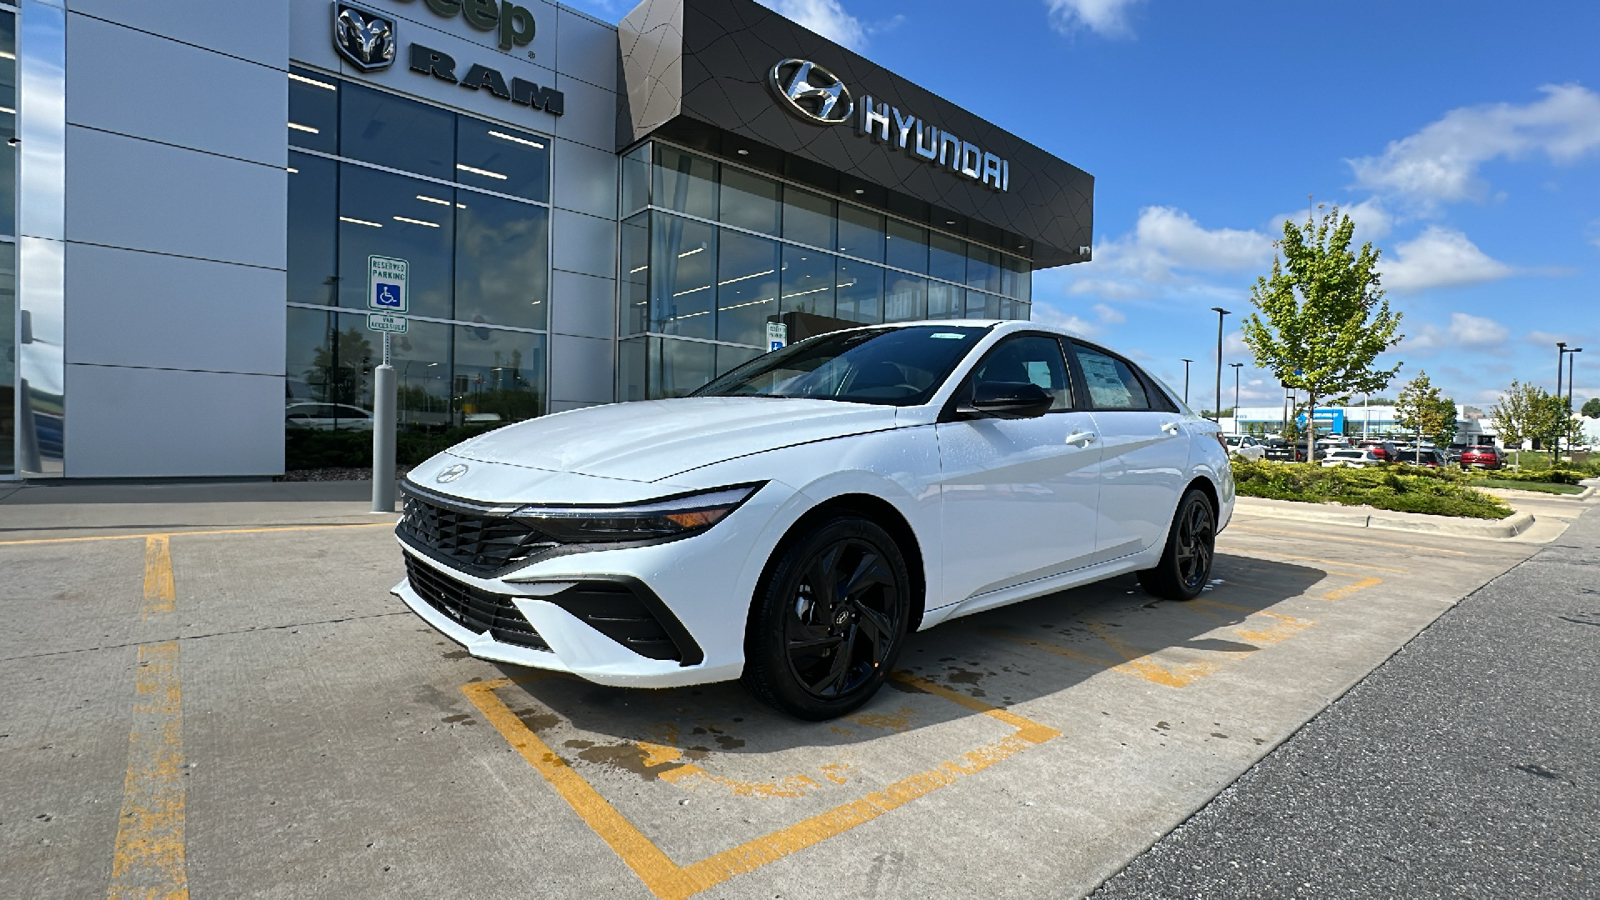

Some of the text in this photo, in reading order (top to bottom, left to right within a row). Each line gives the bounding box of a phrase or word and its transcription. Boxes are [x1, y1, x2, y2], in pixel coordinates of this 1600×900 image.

[409, 42, 564, 117] RAM
[859, 94, 1009, 192] HYUNDAI
[372, 269, 405, 281] PARKING
[373, 260, 405, 272] RESERVED
